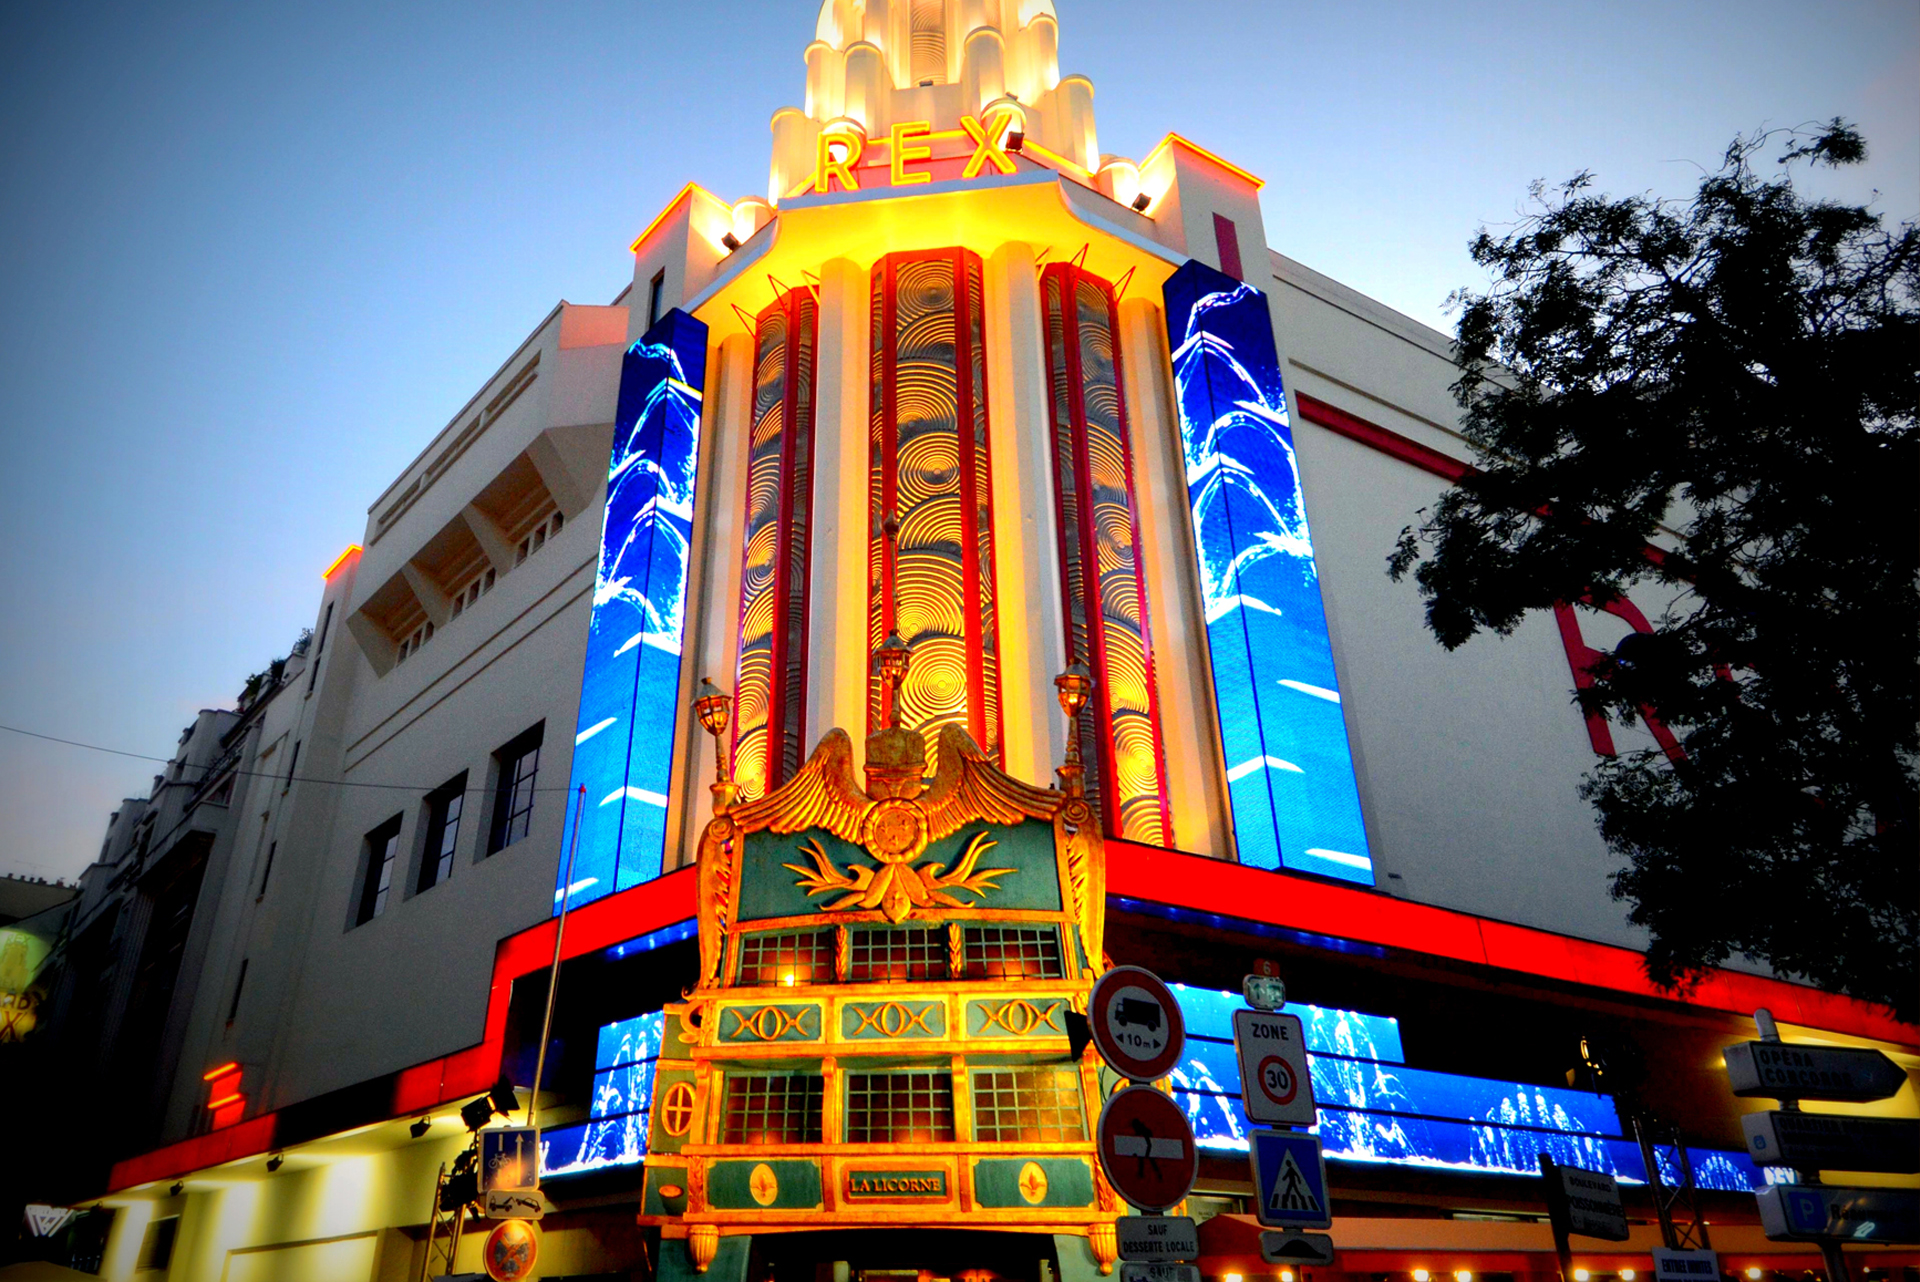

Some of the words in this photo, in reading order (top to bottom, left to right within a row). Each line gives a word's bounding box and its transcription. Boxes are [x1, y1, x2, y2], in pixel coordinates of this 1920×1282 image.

[814, 113, 1018, 193] REX
[1251, 1022, 1289, 1040] ZONE
[1266, 1069, 1288, 1090] 30
[850, 1178, 870, 1192] LA
[873, 1178, 941, 1192] LICORNE
[1800, 1199, 1814, 1220] P
[1147, 1224, 1168, 1235] SAUF
[1123, 1241, 1163, 1253] DESSERTE
[1165, 1241, 1195, 1253] LOCALE
